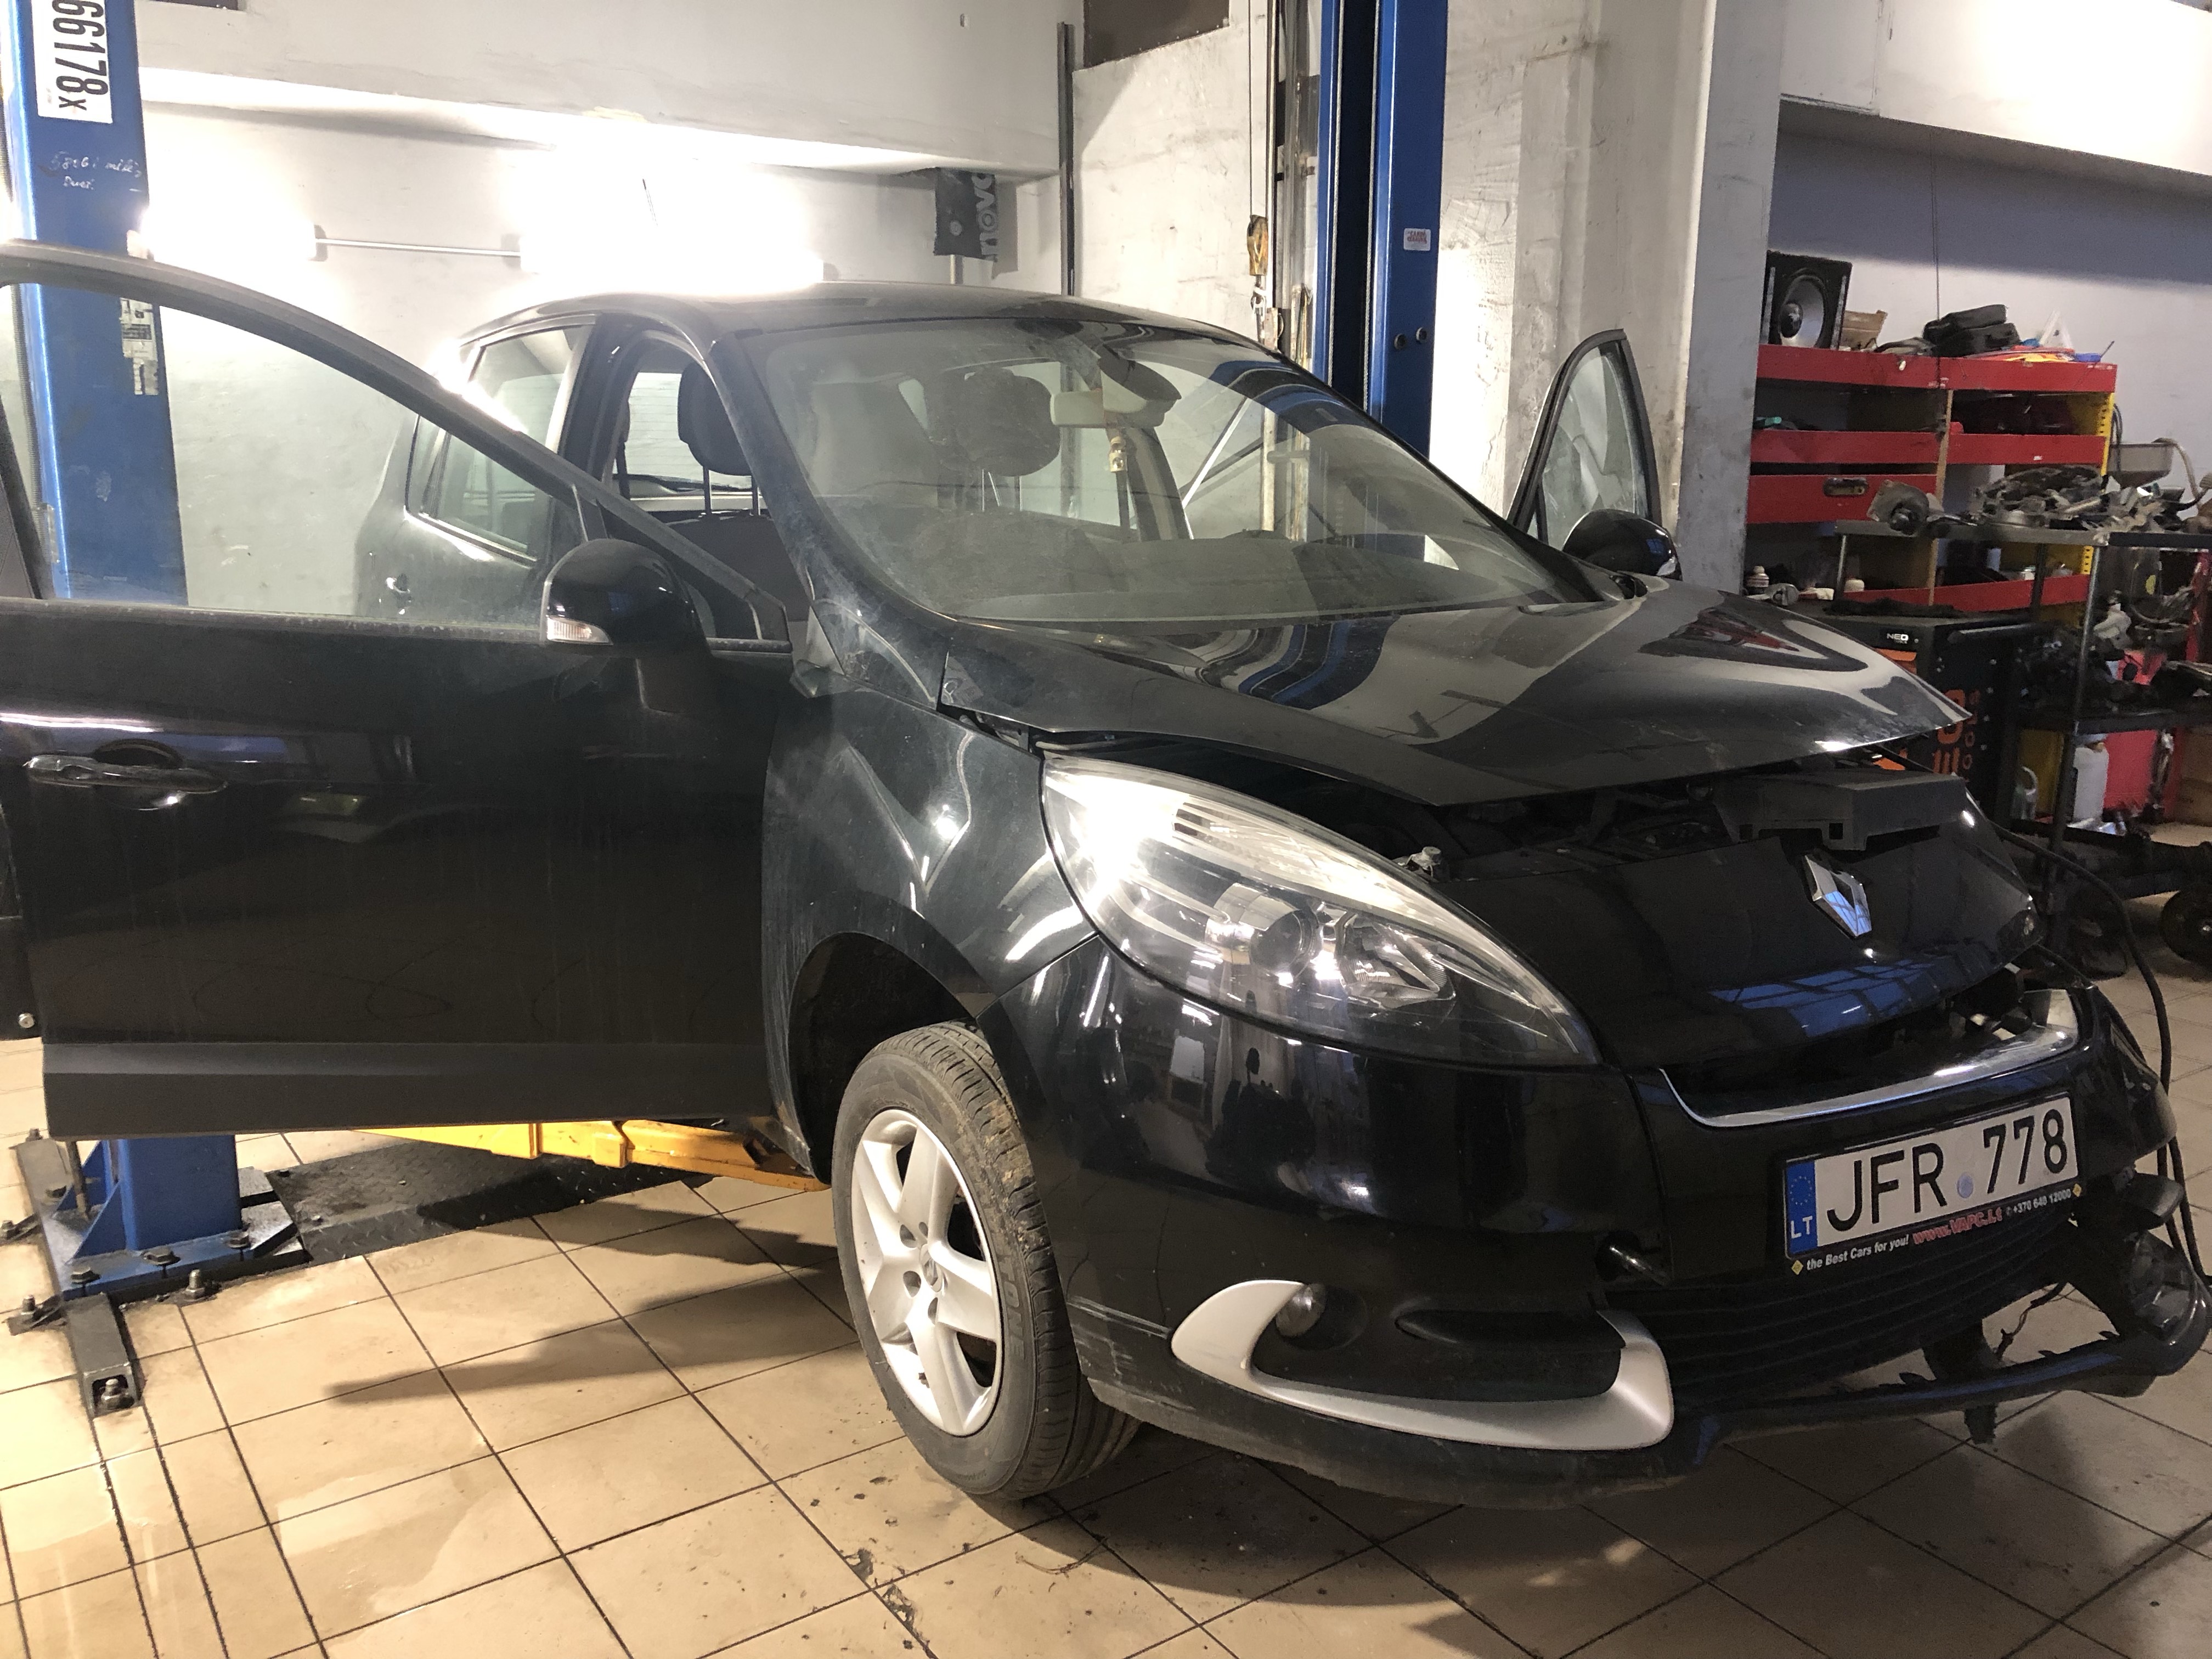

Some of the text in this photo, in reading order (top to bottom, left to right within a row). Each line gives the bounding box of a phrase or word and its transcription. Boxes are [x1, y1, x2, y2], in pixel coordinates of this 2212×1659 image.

[1887, 633, 1909, 641] NEO
[1827, 1109, 2067, 1232] JFR 778
[1791, 1216, 1813, 1238] LT
[1807, 1258, 1822, 1271] the
[1825, 1250, 1848, 1266] Best
[1850, 1245, 1872, 1260] Cars
[1874, 1241, 1887, 1253] for
[1889, 1234, 1909, 1251] you!
[2013, 1200, 2032, 1213] +370
